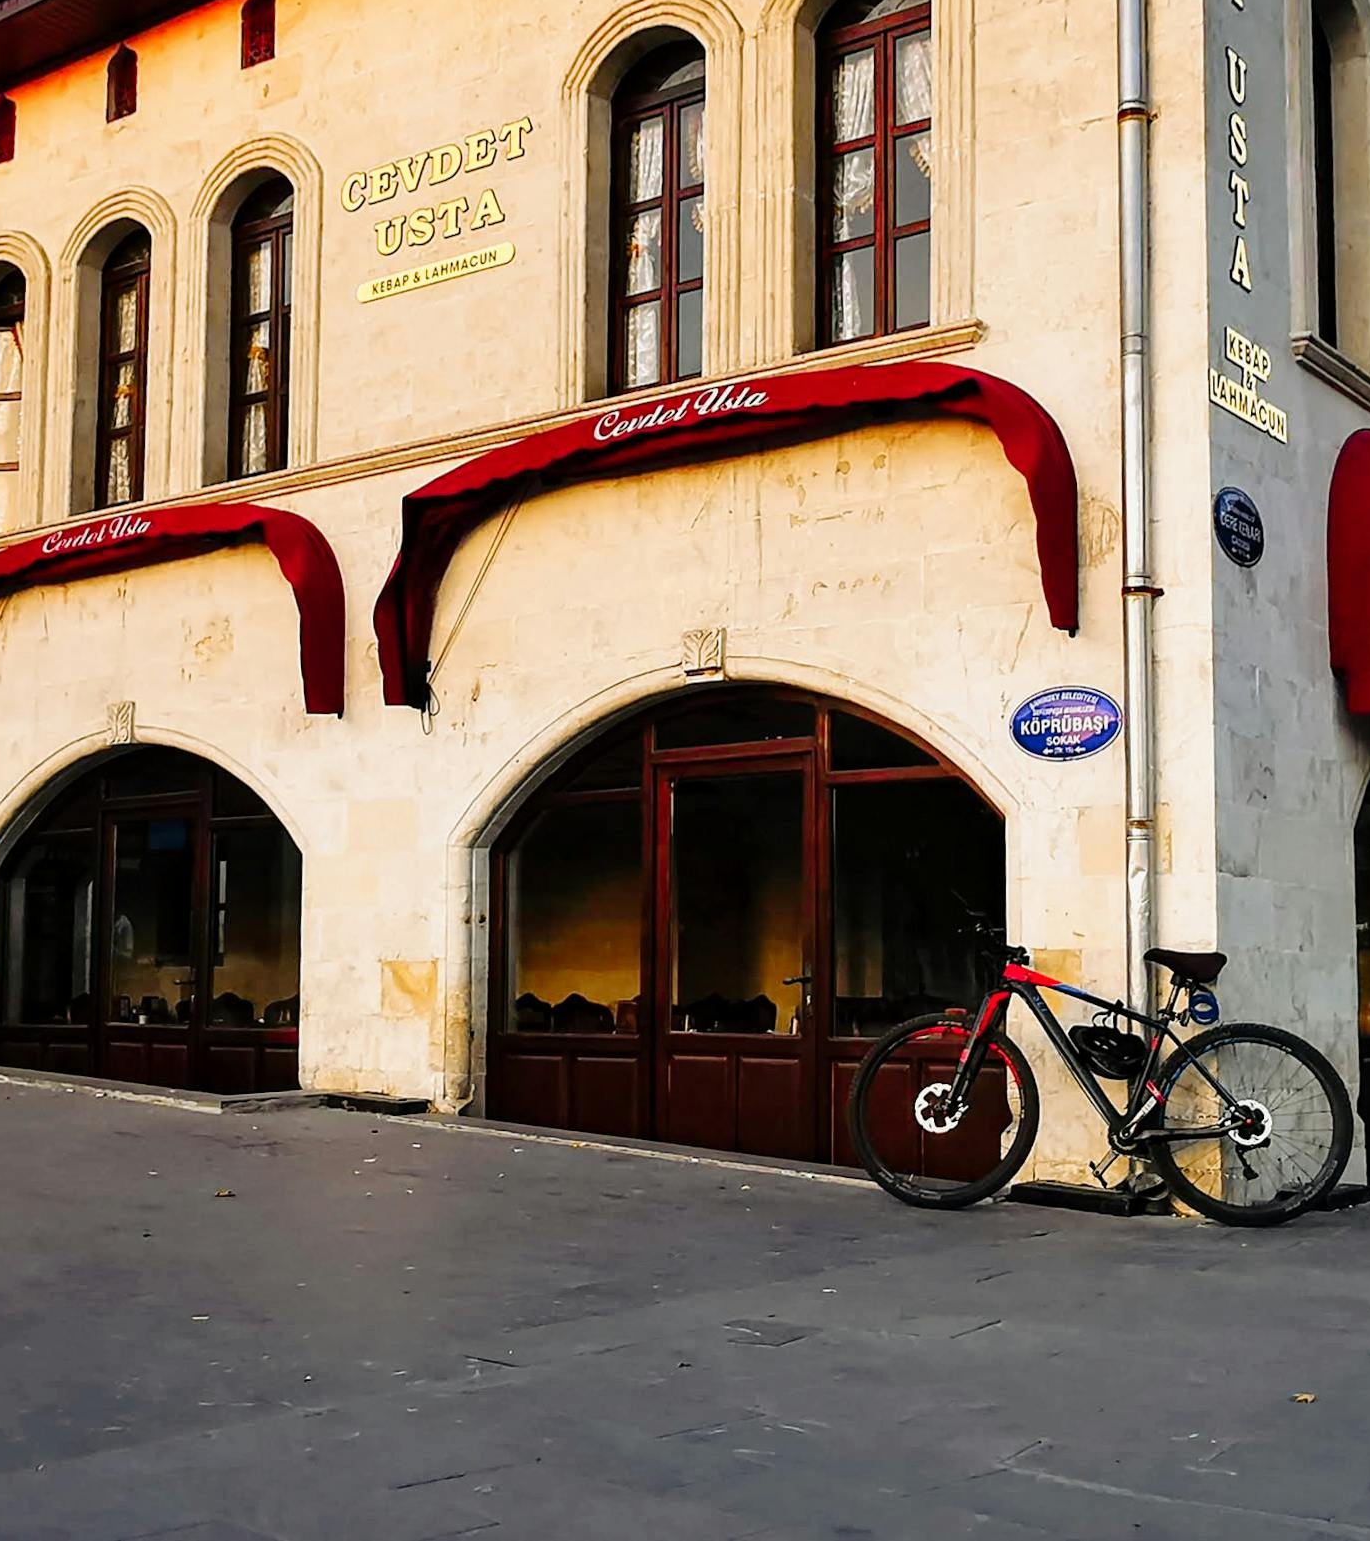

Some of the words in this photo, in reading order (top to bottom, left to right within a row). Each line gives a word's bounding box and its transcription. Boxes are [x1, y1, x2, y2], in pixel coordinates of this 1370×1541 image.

[340, 116, 533, 212] CEVDET
[1226, 46, 1253, 293] USTA
[374, 188, 506, 256] USTA
[372, 274, 409, 295] KEBAP
[413, 272, 421, 284] &
[425, 250, 498, 280] LAHMACUN
[1229, 332, 1269, 375] KEBAP
[1245, 370, 1255, 390] &
[593, 398, 691, 441] Cevdet
[693, 385, 770, 416] Usta
[1212, 375, 1286, 437] LAHMACUN
[1020, 714, 1109, 735] KÖPRÜBAŞI
[1046, 734, 1081, 746] SOKAK
